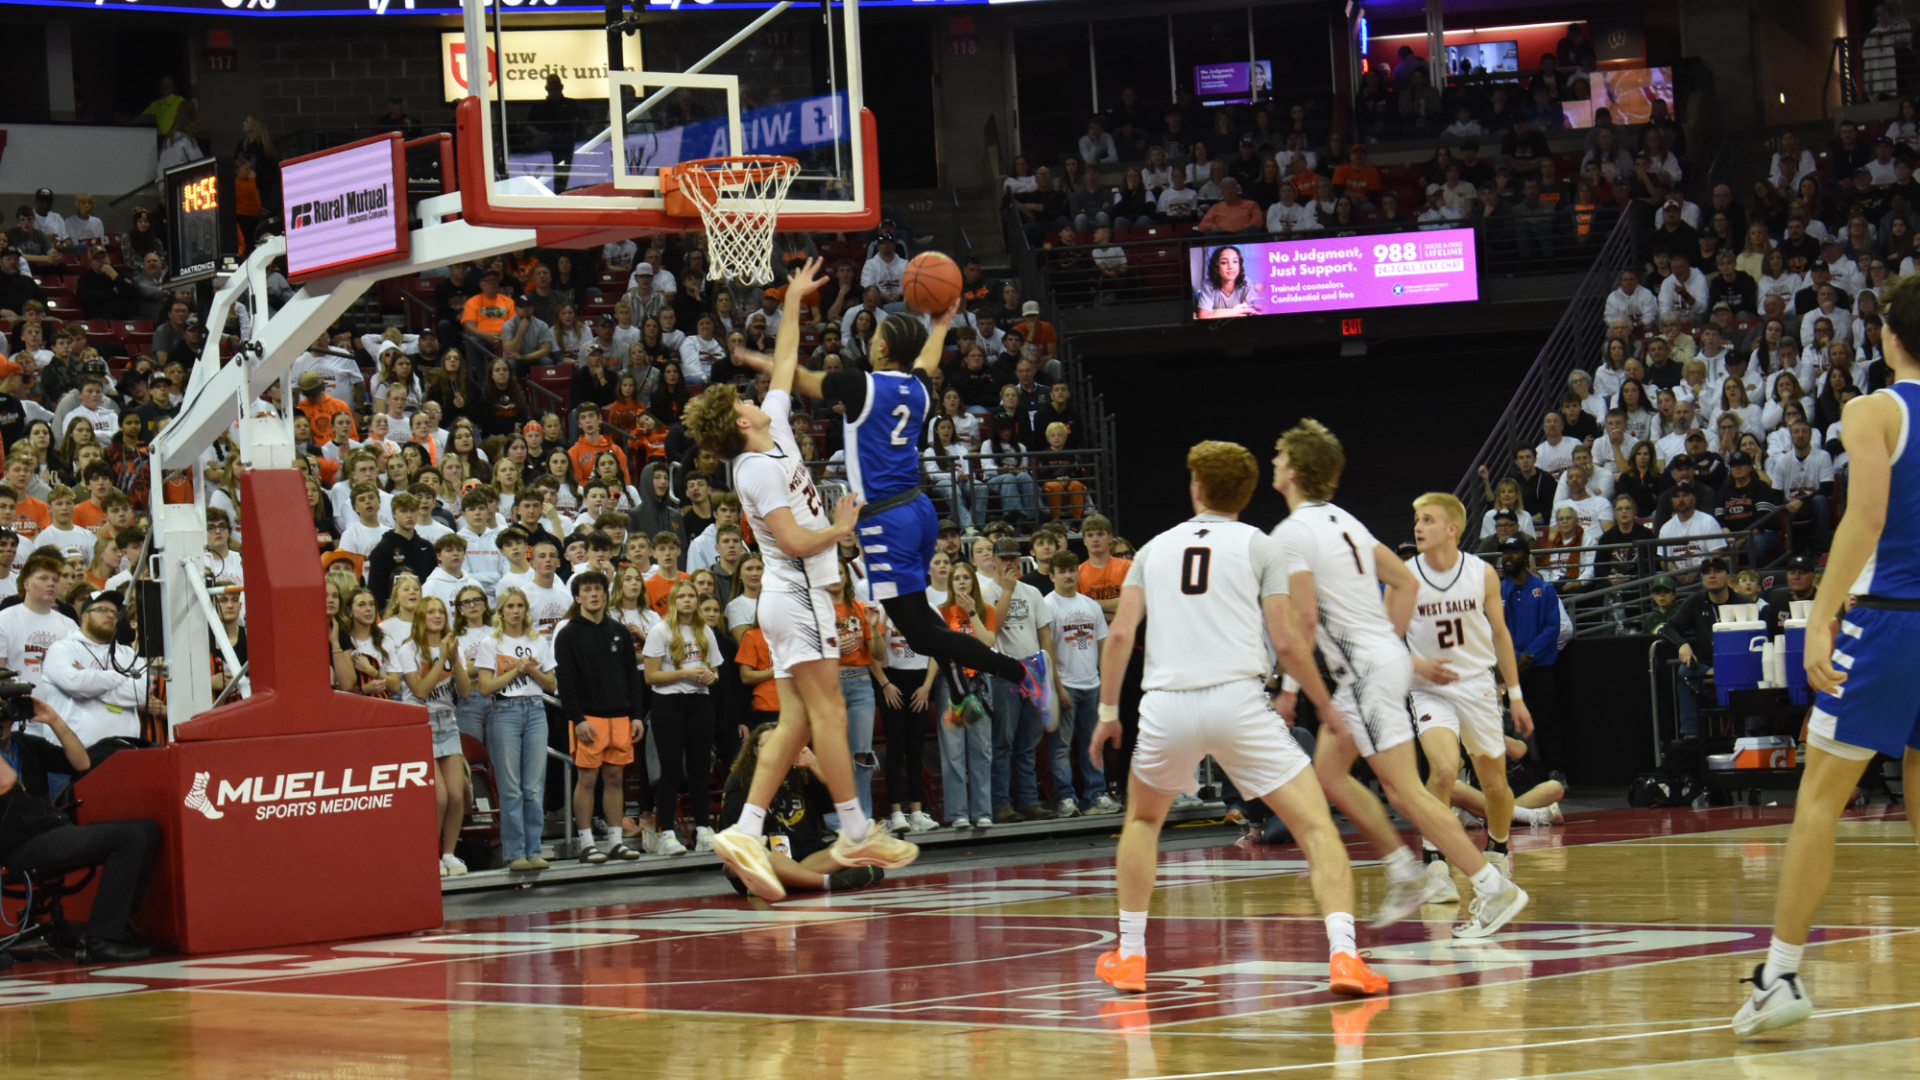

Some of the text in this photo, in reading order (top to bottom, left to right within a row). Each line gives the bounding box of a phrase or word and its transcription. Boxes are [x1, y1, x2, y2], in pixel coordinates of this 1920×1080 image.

[952, 41, 976, 55] 118
[208, 55, 232, 69] 117
[505, 52, 537, 64] uw
[505, 63, 635, 81] credit unin
[313, 183, 388, 224] Rural Mutual
[348, 208, 388, 225] Insurance Company
[1269, 247, 1362, 263] No Judgment,
[1373, 242, 1417, 263] 988
[1425, 247, 1463, 257] LIFELINE
[180, 260, 216, 276] DAKTRONICS
[1270, 261, 1357, 277] Just Support.
[1378, 265, 1395, 274] 24/7
[1441, 260, 1461, 270] CHAT
[1270, 280, 1344, 293] Trained counselors
[1271, 290, 1354, 303] Confidential and free
[1342, 318, 1362, 335] EXIT
[889, 404, 911, 446] 2
[1342, 531, 1365, 575] 1
[1181, 546, 1212, 595] 0
[1762, 576, 1774, 590] W
[655, 593, 669, 608] WES
[1532, 588, 1542, 598] W
[1417, 599, 1477, 617] WEST SALEM
[1435, 617, 1465, 649] 21
[515, 646, 533, 658] GO
[1769, 749, 1787, 769] G
[216, 761, 429, 806] MUELLER
[255, 793, 394, 820] SPORTS MEDICINE
